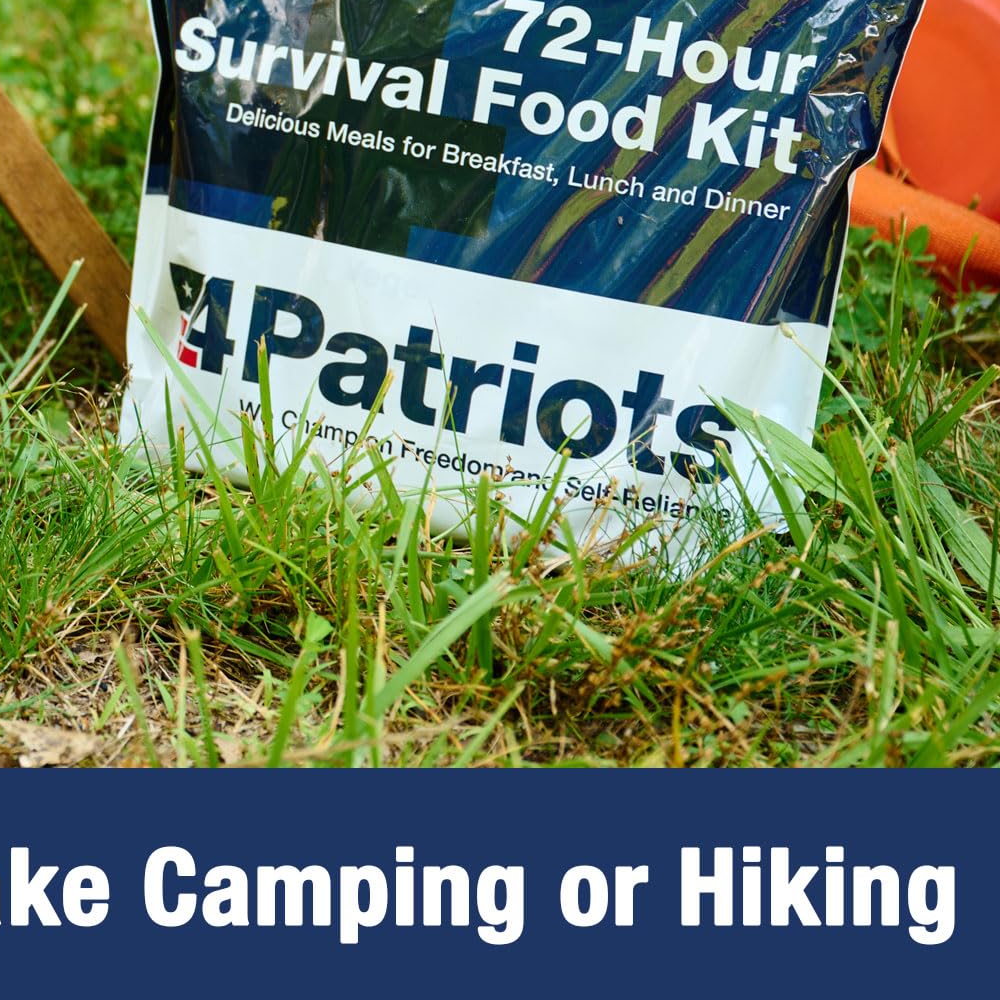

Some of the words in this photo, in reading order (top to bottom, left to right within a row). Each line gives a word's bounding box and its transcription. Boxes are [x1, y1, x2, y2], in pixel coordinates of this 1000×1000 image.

[174, 16, 450, 116] Survival
[472, 66, 662, 152] Food
[686, 101, 803, 175] Kit
[225, 102, 321, 138] Delicious
[326, 121, 396, 153] Meals
[402, 136, 437, 160] for
[441, 142, 560, 187] Breakfast,
[567, 166, 645, 198] Lunch
[652, 184, 697, 206] and
[704, 189, 791, 222] Dinner
[169, 262, 736, 485] 4Patriots
[281, 409, 393, 455] Campon
